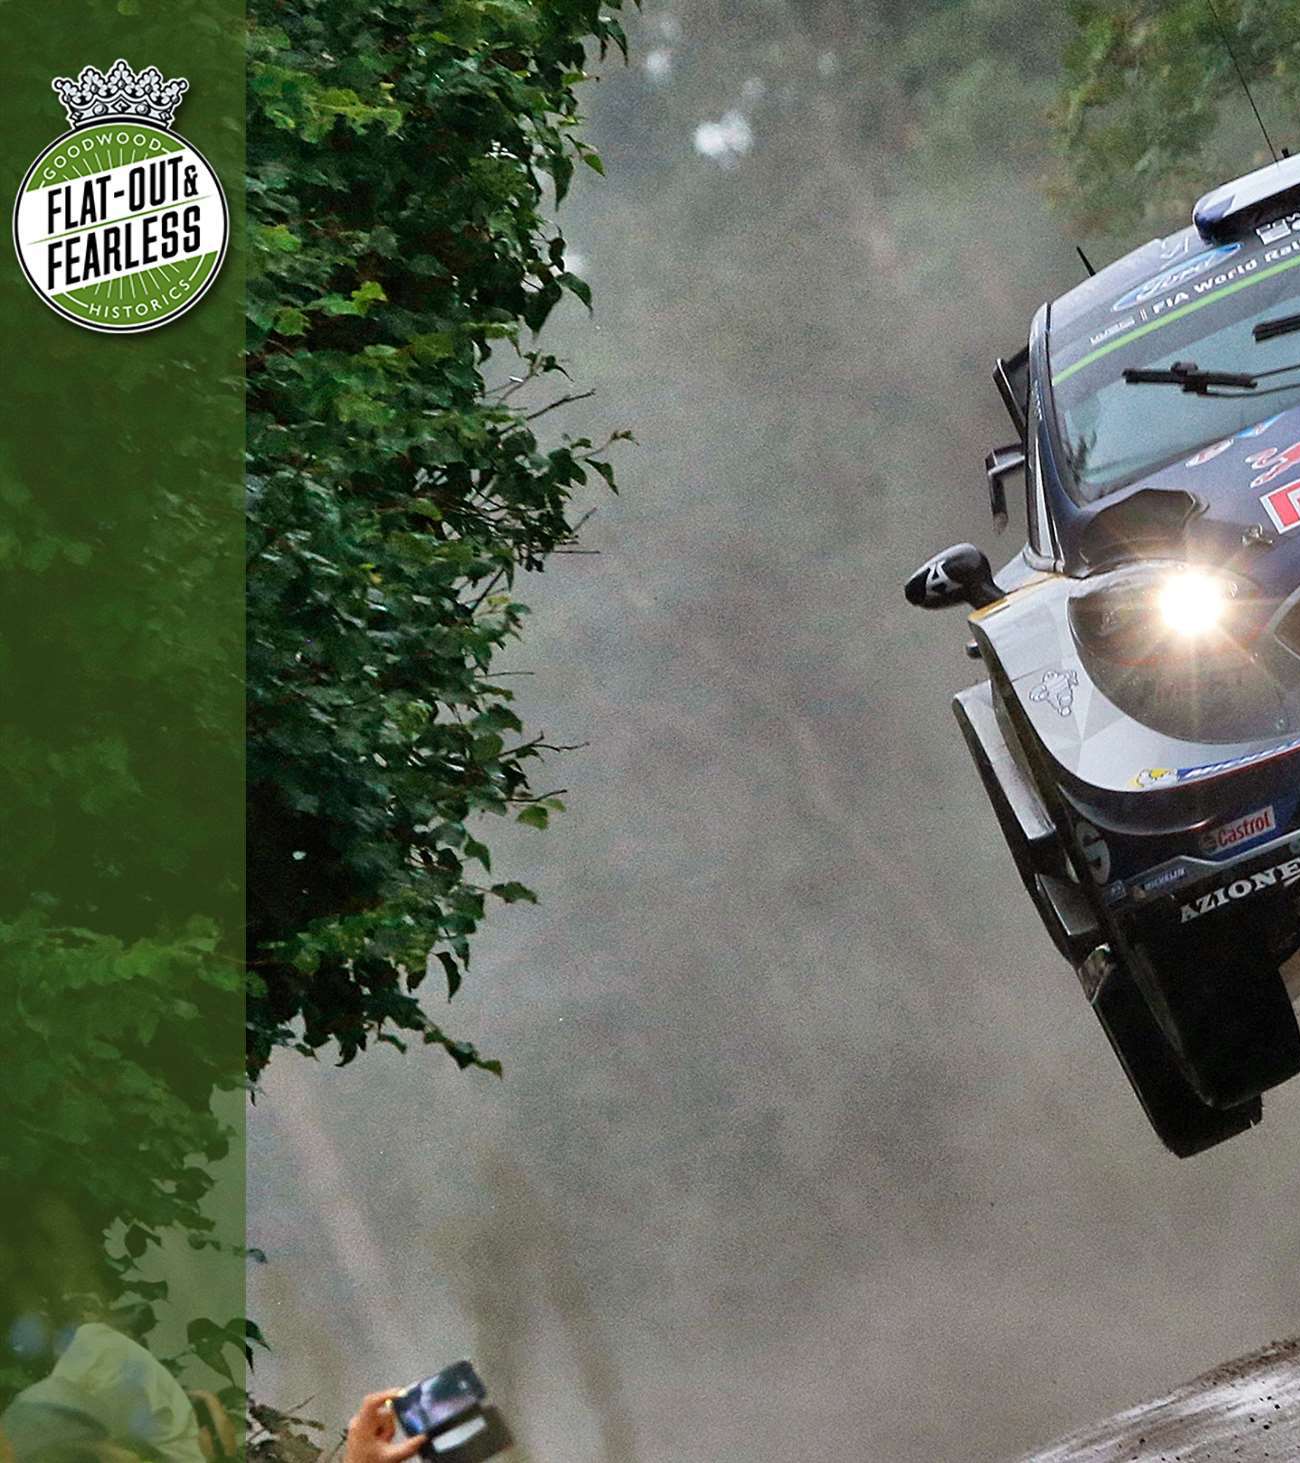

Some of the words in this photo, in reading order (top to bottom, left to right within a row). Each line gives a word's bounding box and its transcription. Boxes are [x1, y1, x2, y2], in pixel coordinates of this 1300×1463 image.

[1152, 292, 1189, 314] FIA
[1193, 259, 1258, 293] World
[1217, 811, 1271, 848] Castrol
